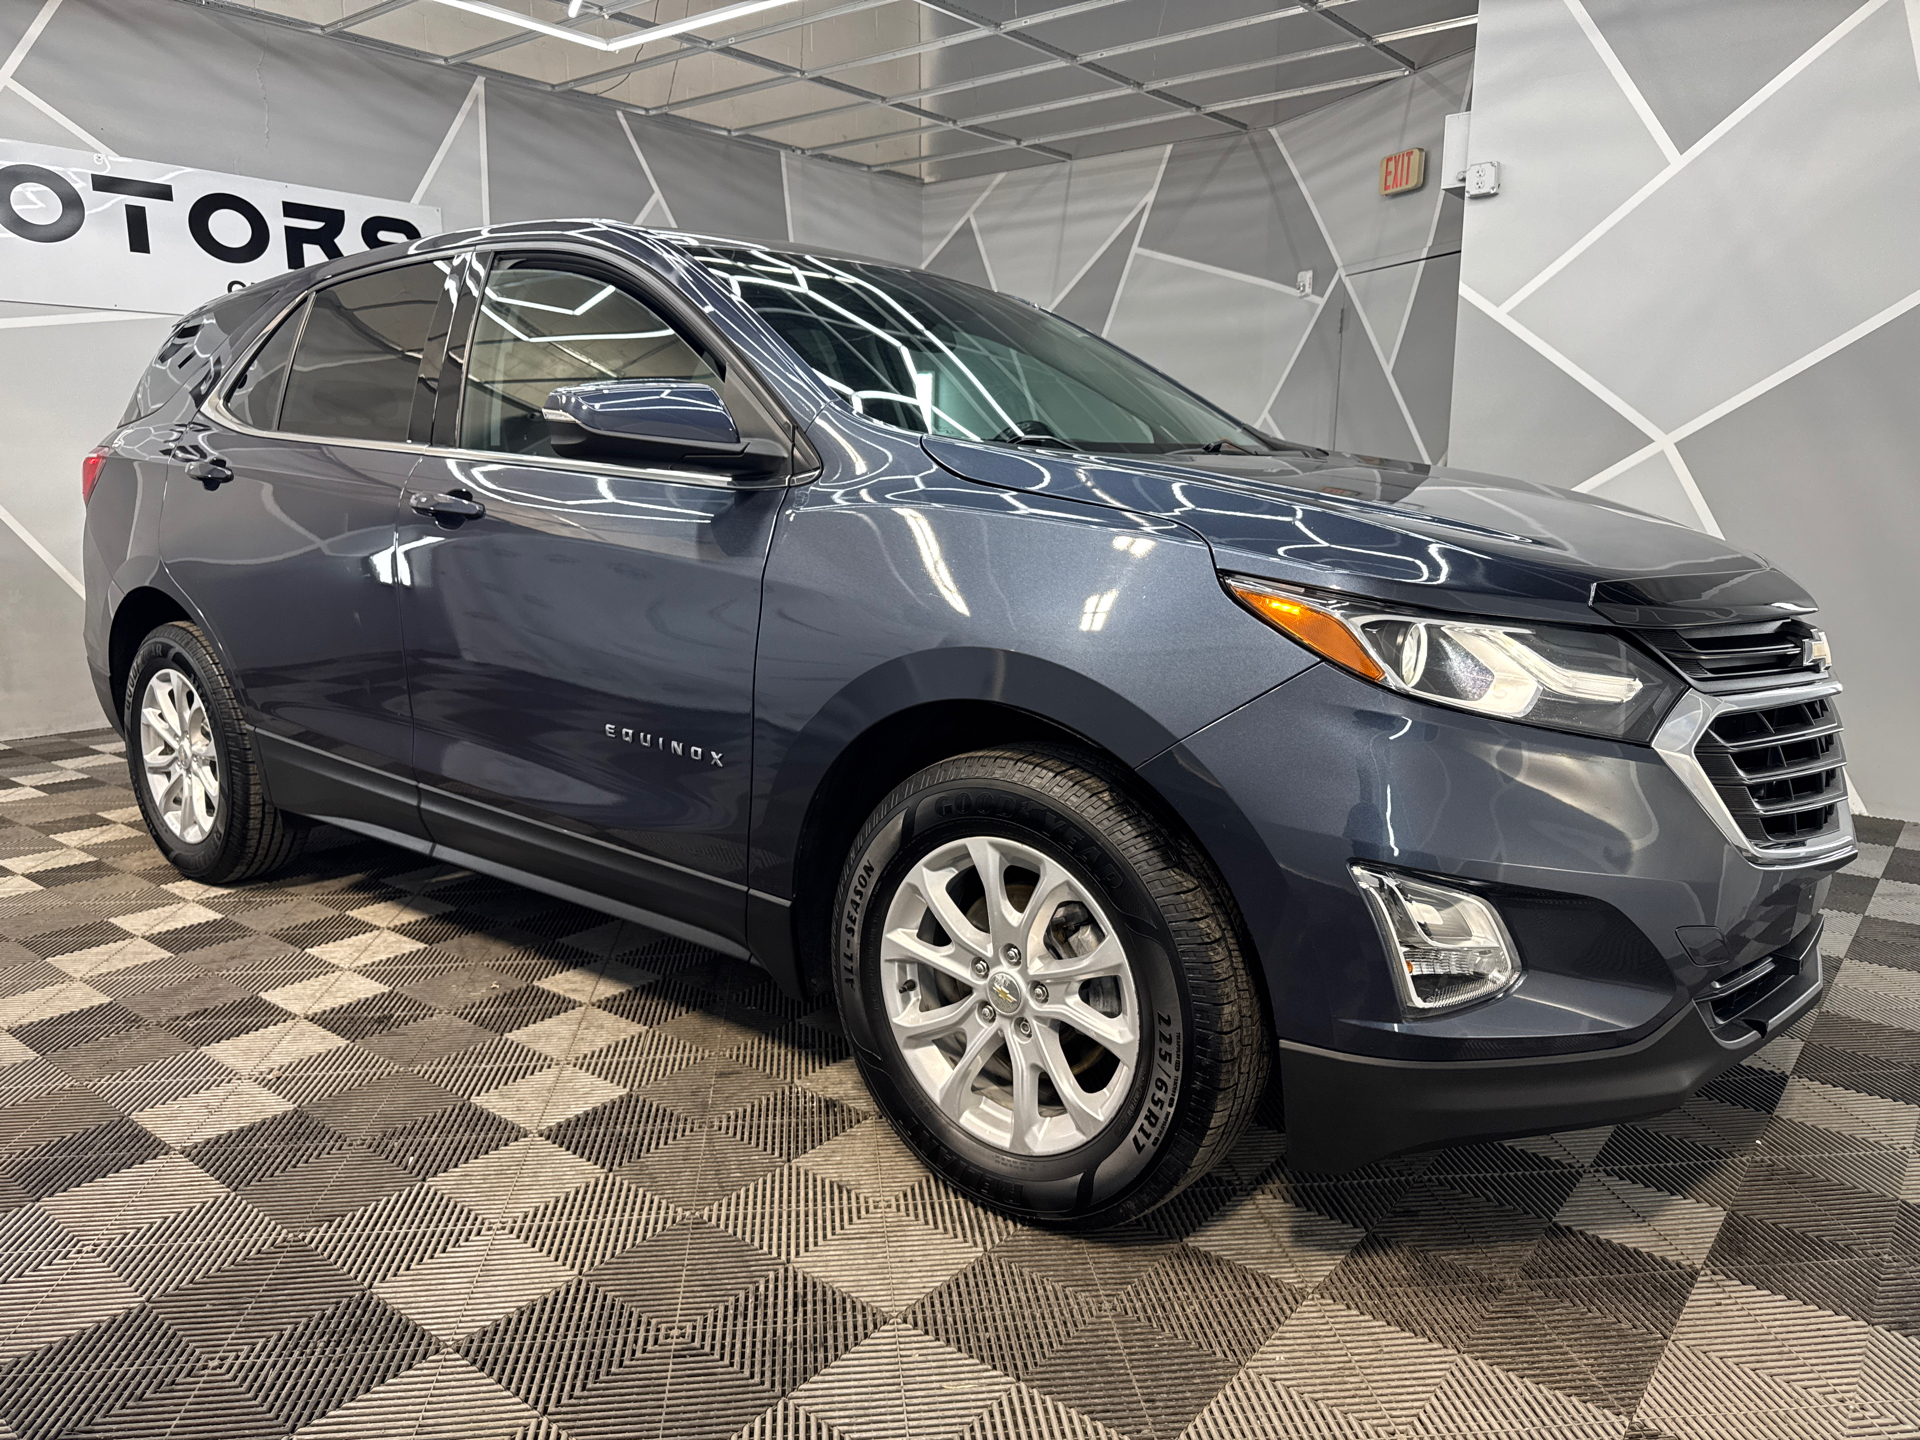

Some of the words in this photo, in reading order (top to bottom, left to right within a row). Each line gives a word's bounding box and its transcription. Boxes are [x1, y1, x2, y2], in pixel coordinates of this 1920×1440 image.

[1384, 151, 1414, 191] EXIT
[605, 723, 724, 768] EQUINOX
[840, 859, 875, 990] ALL-SEASON
[1133, 1010, 1173, 1156] 225/65R17
